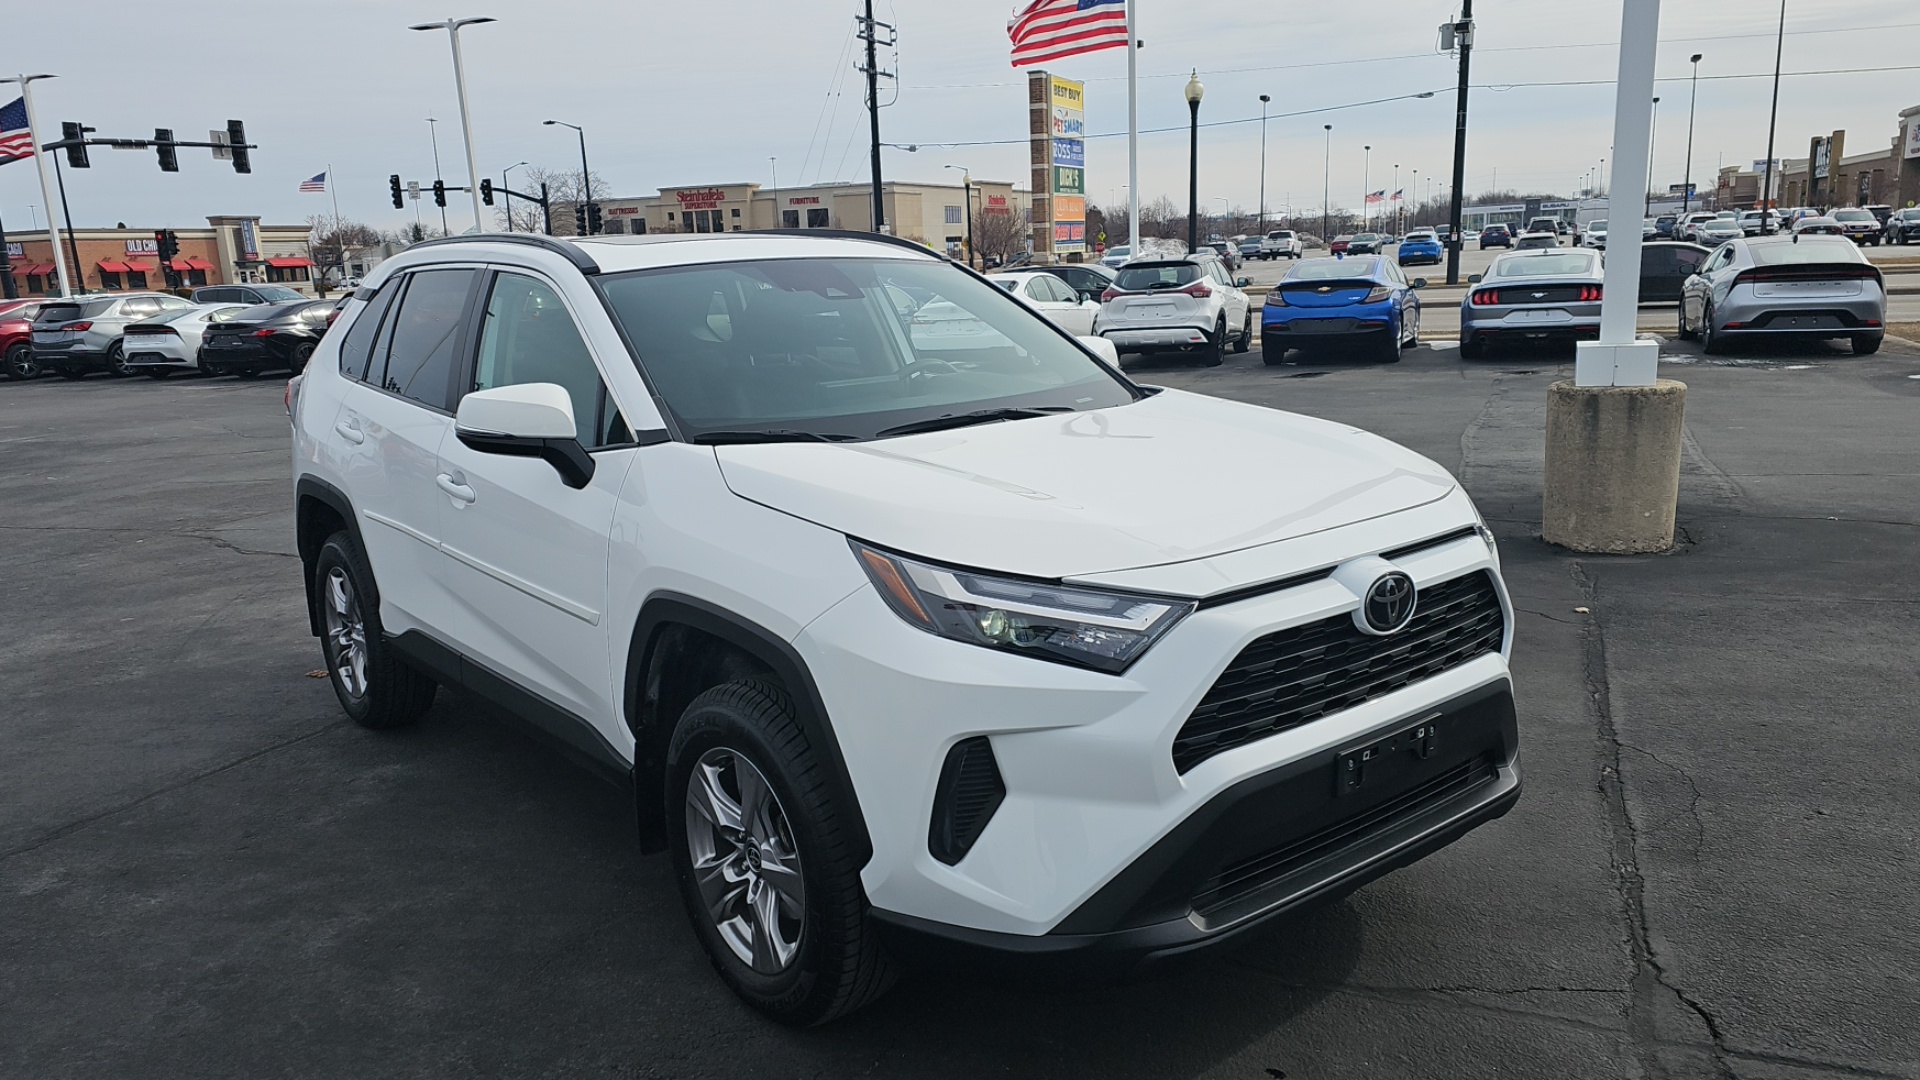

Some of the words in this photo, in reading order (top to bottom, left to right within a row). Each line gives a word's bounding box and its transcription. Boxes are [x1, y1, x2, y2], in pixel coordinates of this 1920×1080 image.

[1053, 84, 1068, 98] BEST
[1069, 87, 1081, 101] BUY
[1059, 167, 1079, 187] DICK'S
[676, 188, 725, 203] Steinhafels
[789, 196, 820, 206] FURNITURE
[684, 201, 718, 210] SUPERSTORE
[126, 239, 143, 252] OLD
